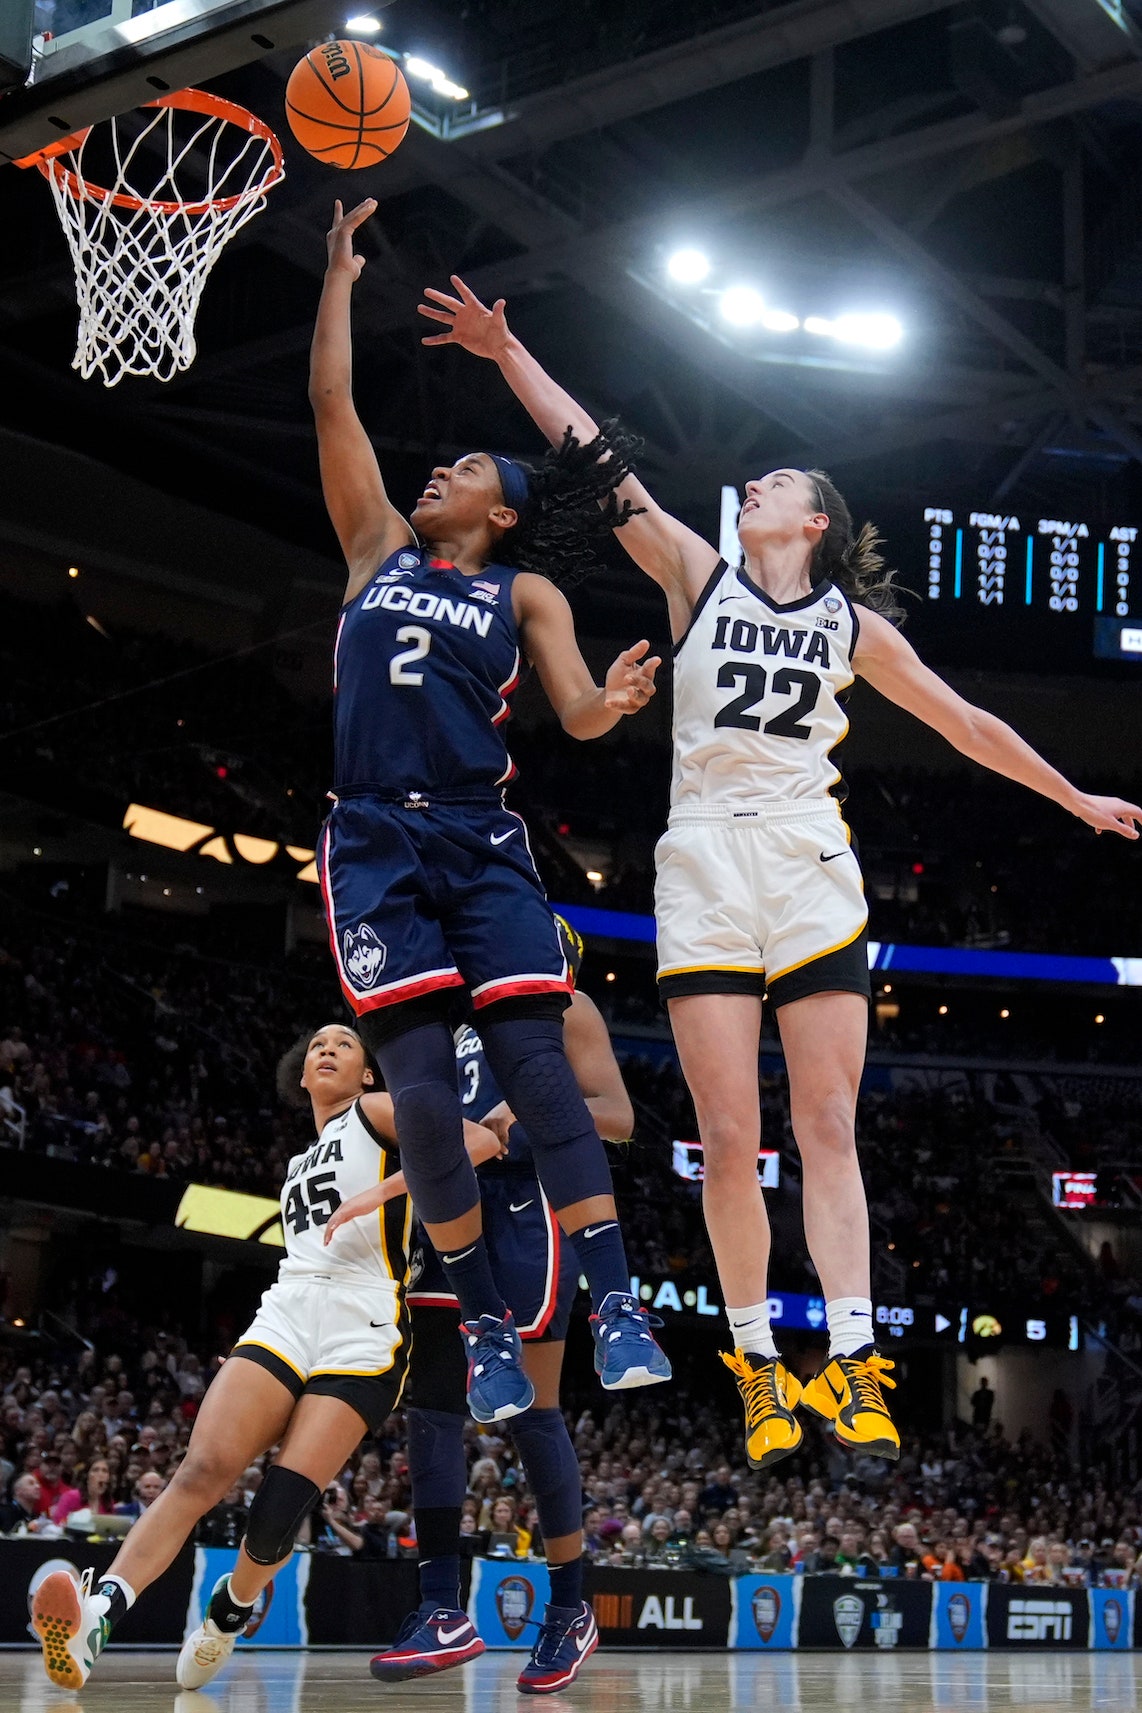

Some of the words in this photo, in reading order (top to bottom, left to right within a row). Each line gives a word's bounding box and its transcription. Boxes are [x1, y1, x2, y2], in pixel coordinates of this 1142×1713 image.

[923, 507, 953, 524] PTS
[1109, 526, 1138, 542] AST
[361, 584, 495, 638] UCONN
[389, 625, 432, 687] 2
[711, 616, 831, 670] IOWA
[714, 661, 822, 740] 22
[462, 1059, 480, 1105] 3
[285, 1171, 343, 1236] 45
[1026, 1319, 1047, 1340] 5
[637, 1595, 703, 1630] ALL
[1006, 1599, 1072, 1640] ESPN
